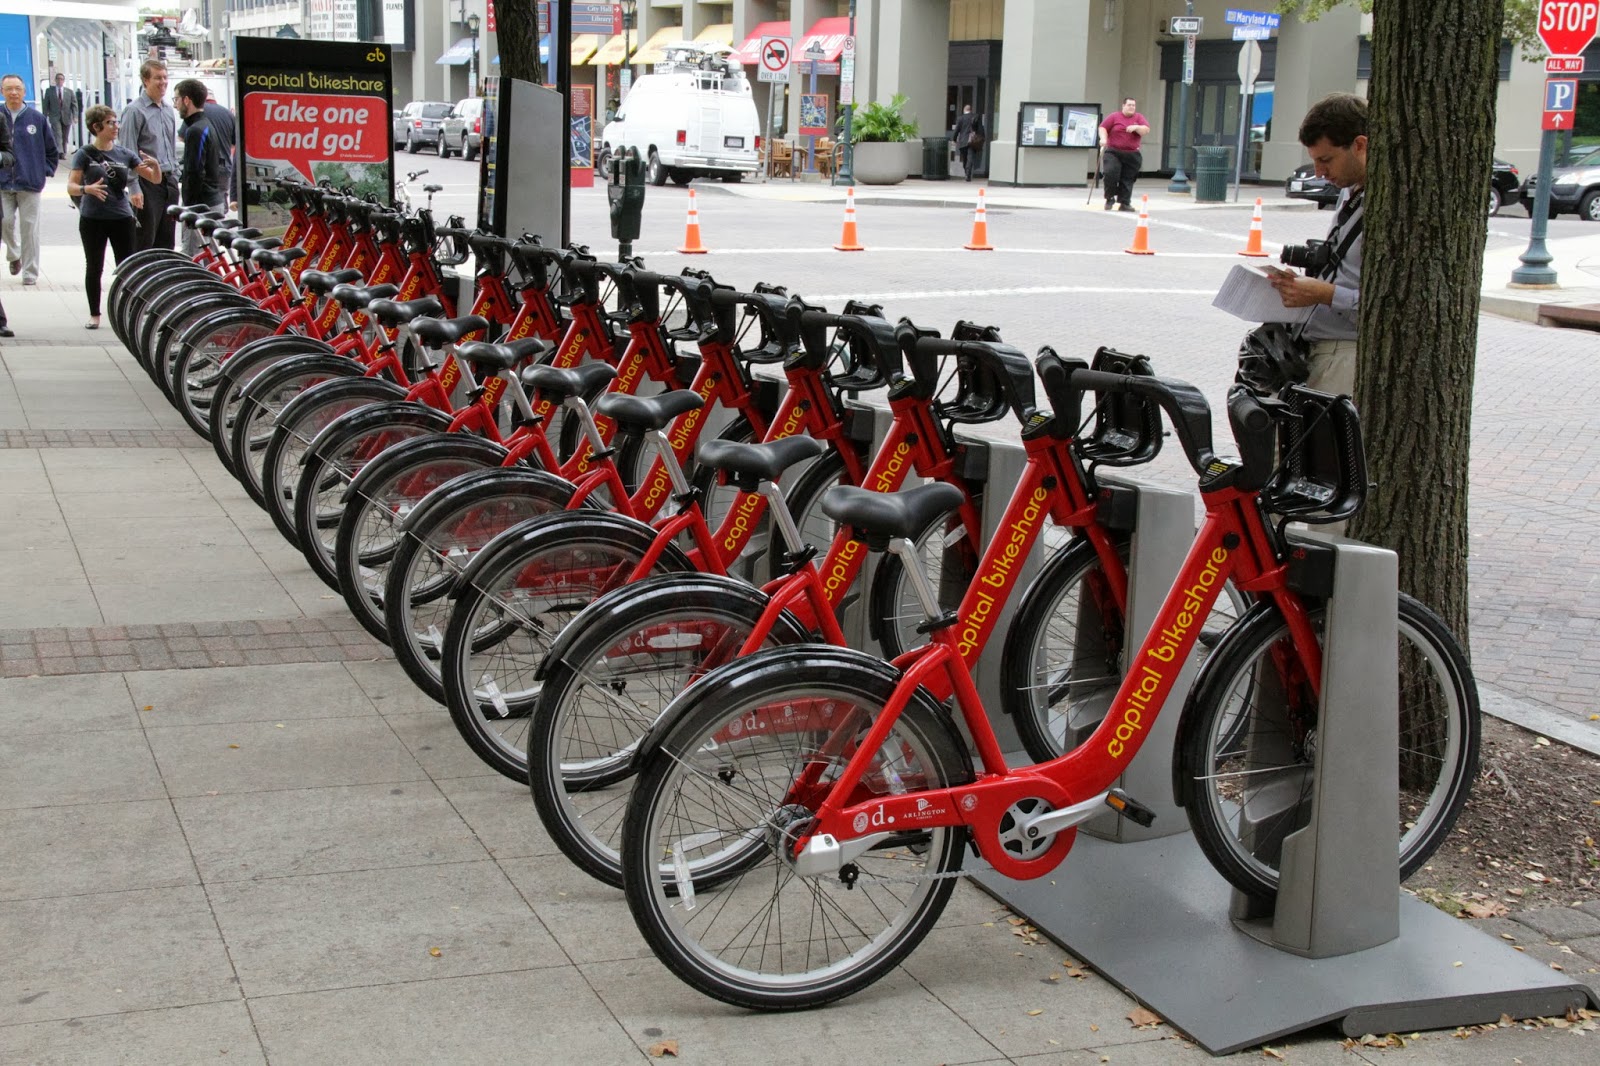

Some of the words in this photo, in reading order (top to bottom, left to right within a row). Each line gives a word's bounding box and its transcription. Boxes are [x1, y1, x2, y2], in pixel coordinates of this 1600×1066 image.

[1188, 21, 1196, 29] WAY
[1236, 12, 1266, 24] Maryland
[1266, 15, 1279, 26] Ave
[1542, 2, 1597, 31] STOP
[761, 72, 773, 80] OVER
[1547, 60, 1562, 70] ALL
[1564, 60, 1581, 70] WAY
[246, 73, 304, 90] capital
[308, 71, 384, 91] bikeshare
[1552, 84, 1571, 108] P
[262, 99, 319, 123] Take
[323, 107, 369, 125] one
[269, 127, 319, 150] and
[322, 130, 363, 156] go!
[403, 276, 420, 302] share
[561, 333, 585, 368] share
[618, 353, 643, 394] share
[644, 466, 669, 509] capit
[724, 491, 761, 551] capita
[824, 540, 859, 601] capita
[877, 442, 910, 493] share
[958, 591, 995, 657] apital
[981, 487, 1047, 588] bikeshare
[1107, 666, 1162, 759] capital
[1147, 546, 1228, 663] bikeshare
[871, 804, 895, 827] d.
[903, 808, 946, 819] ARLINGTON
